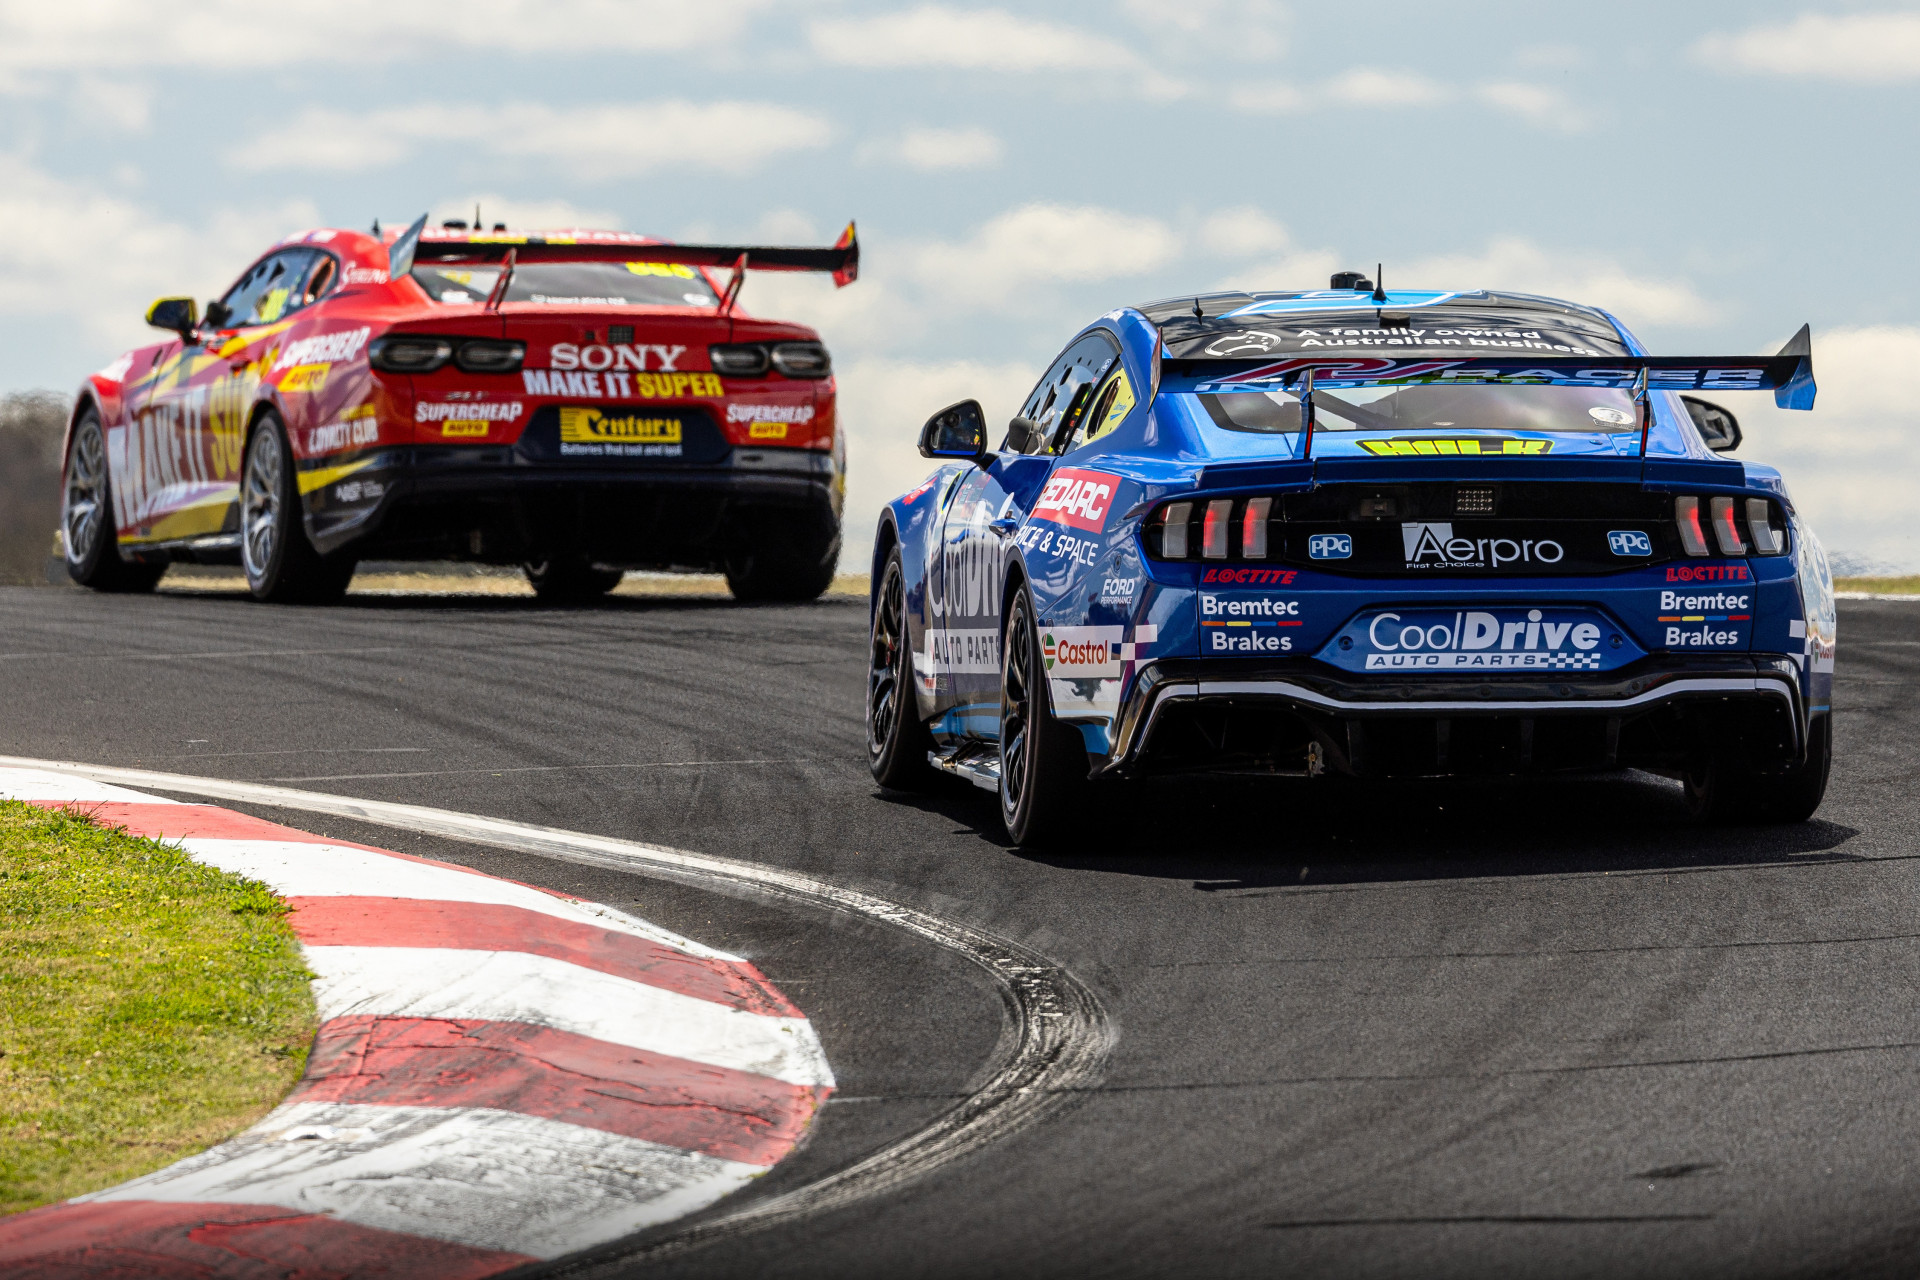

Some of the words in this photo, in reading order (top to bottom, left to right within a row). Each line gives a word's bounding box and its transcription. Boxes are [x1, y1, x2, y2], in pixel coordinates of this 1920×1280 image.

[1297, 329, 1314, 338] A
[1329, 327, 1426, 337] family
[1435, 328, 1541, 339] owned
[551, 342, 687, 372] SONY
[1300, 338, 1464, 348] Australian
[1469, 337, 1600, 357] business
[522, 369, 602, 397] MAKE
[604, 372, 631, 398] IT
[636, 372, 724, 398] SUPER
[1440, 368, 1764, 381] RACER
[415, 400, 523, 423] SUPERCHEAP
[727, 403, 815, 425] SUPERCHEAP
[560, 407, 682, 442] Century
[1039, 531, 1054, 553] &
[1051, 535, 1098, 566] SPACE
[1311, 536, 1350, 557] PPG
[1413, 524, 1564, 568] Aerpro
[1610, 533, 1648, 553] PPG
[1434, 561, 1485, 569] Choice
[1666, 566, 1748, 582] LOCTITE
[1203, 568, 1298, 584] LOCTITE
[1102, 578, 1135, 595] FORD
[1100, 596, 1133, 605] PERFORMANCE
[1202, 595, 1299, 615] Bremtec
[1660, 591, 1749, 610] Bremtec
[1369, 609, 1601, 650] CoolDrive
[1665, 625, 1739, 646] Brakes
[1212, 630, 1292, 650] Brakes
[933, 636, 962, 665] AUTO
[1058, 639, 1108, 665] Castrol
[1373, 655, 1440, 666] AUTO
[1455, 655, 1537, 666] PARTS
